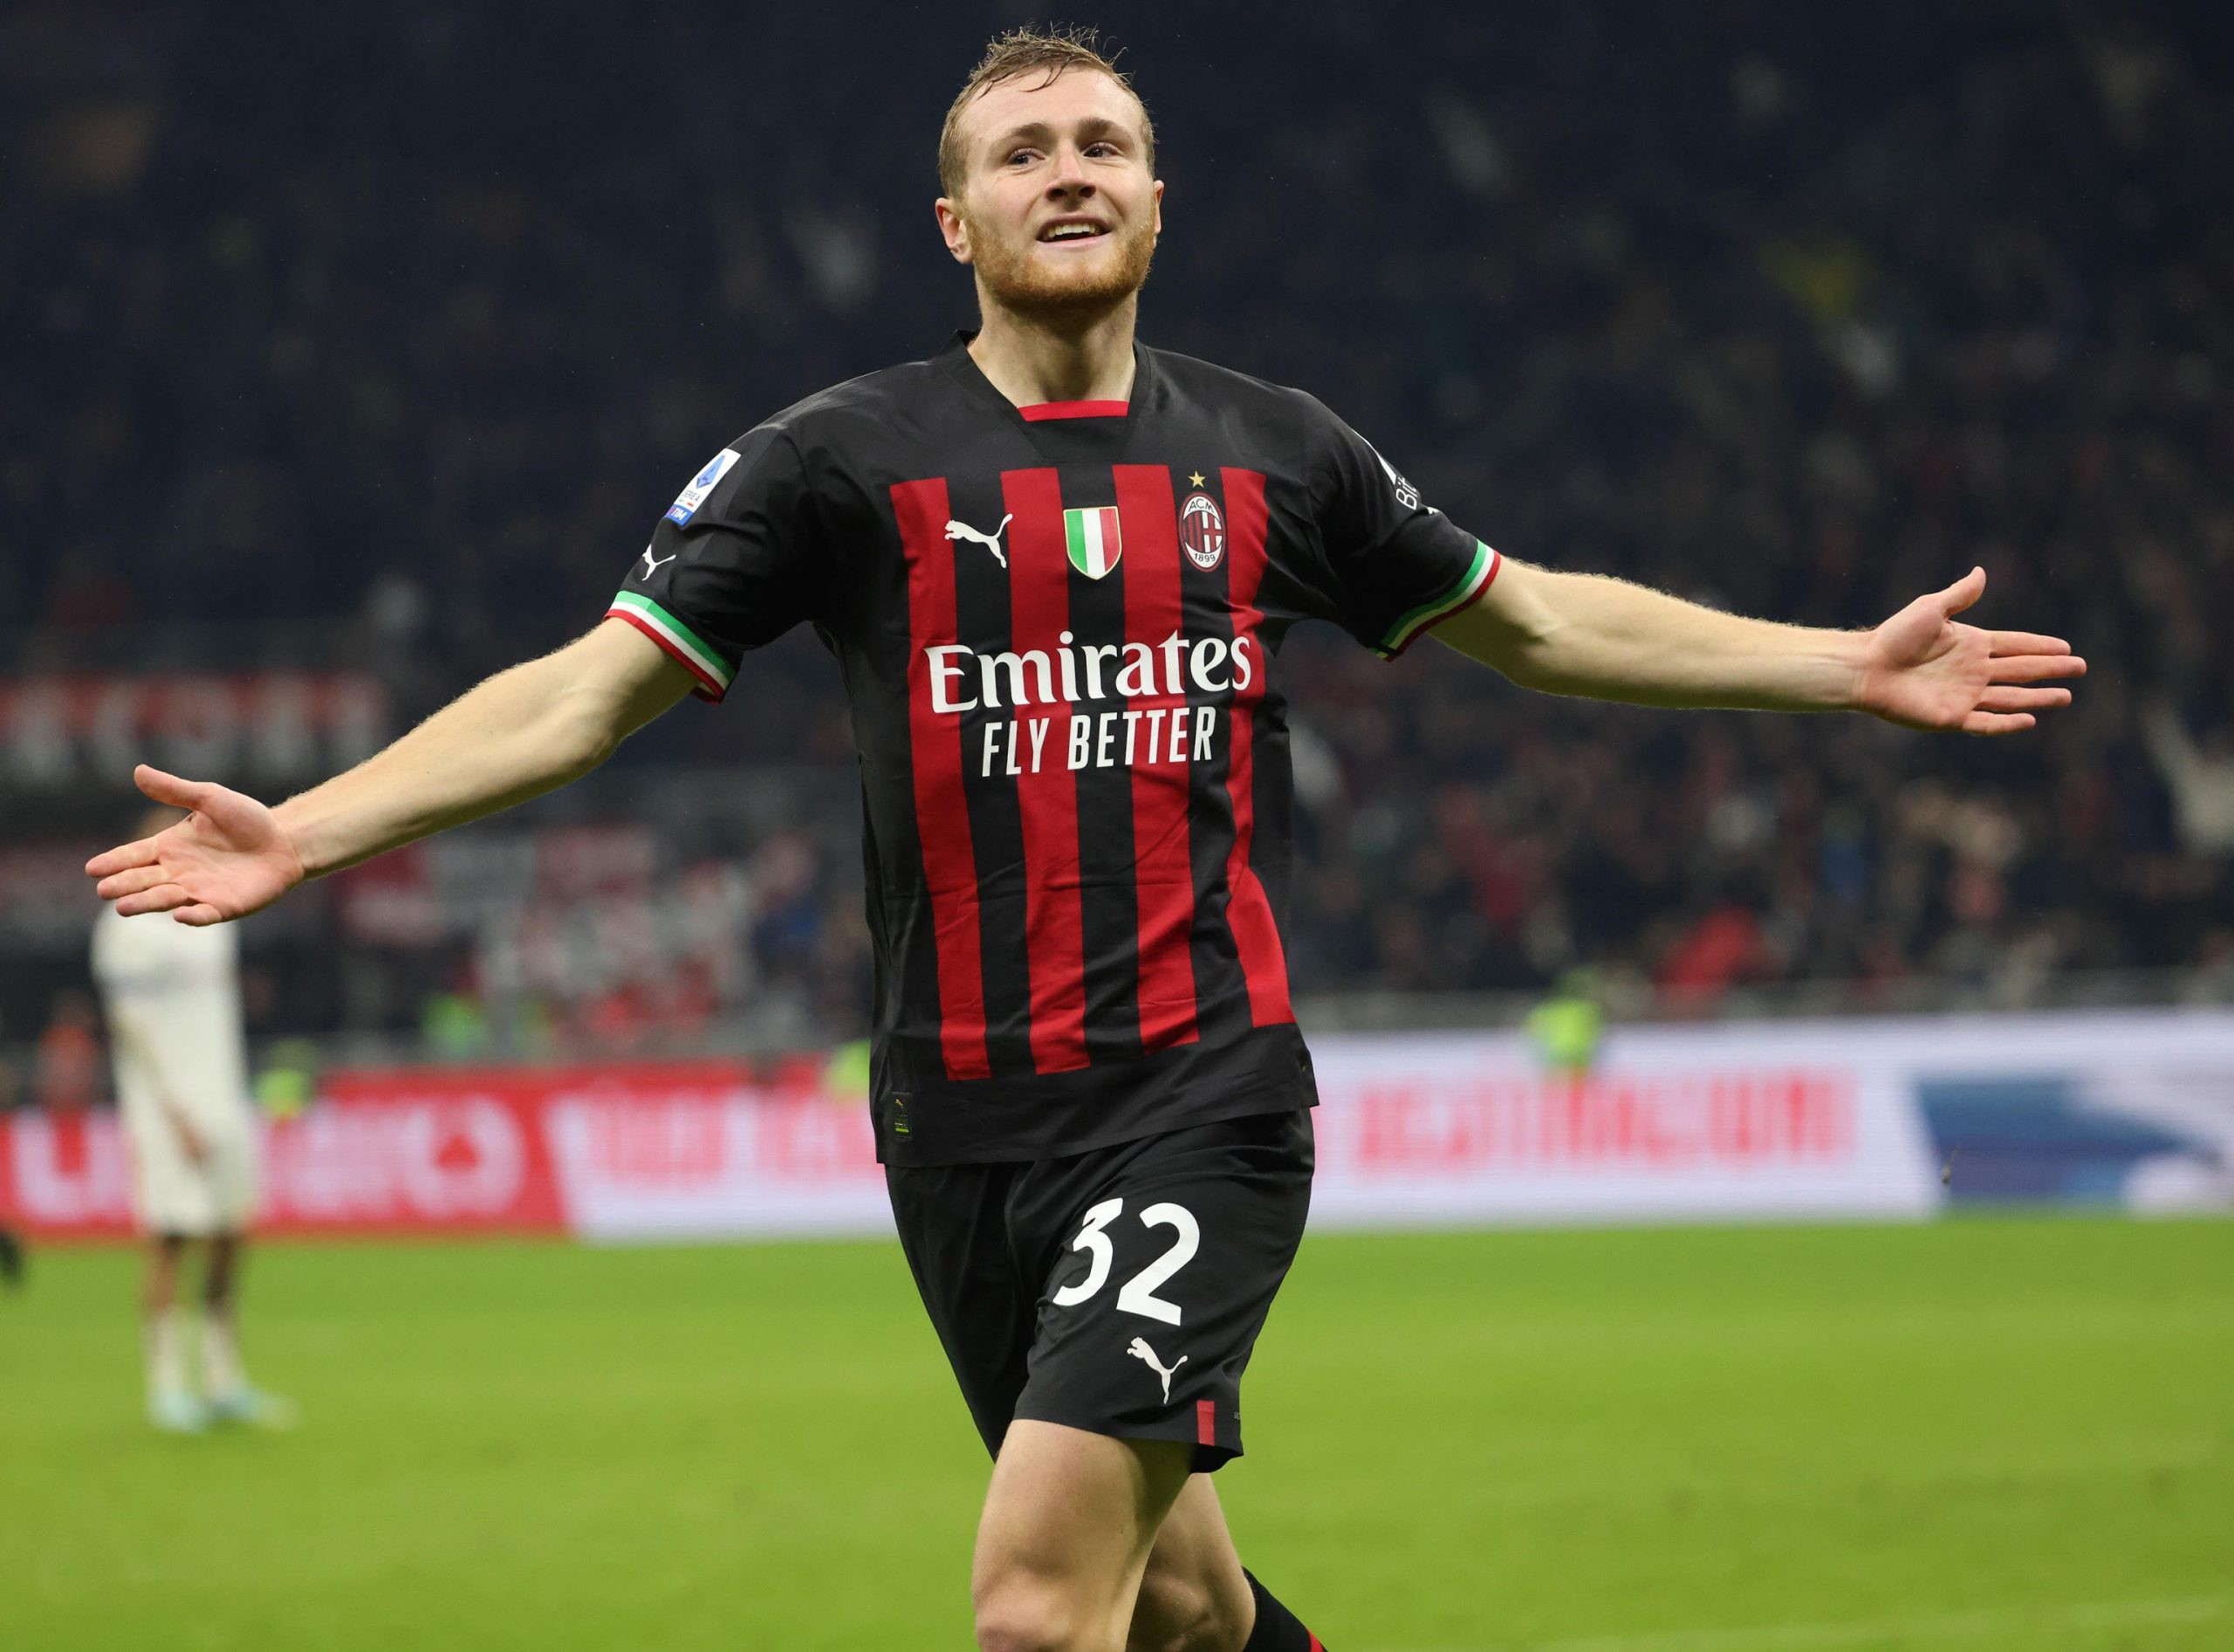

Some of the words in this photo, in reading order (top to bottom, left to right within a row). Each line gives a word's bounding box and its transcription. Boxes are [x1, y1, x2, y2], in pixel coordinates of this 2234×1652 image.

[670, 507, 688, 521] TIM
[1188, 498, 1215, 513] ACM
[1194, 552, 1216, 563] 1899
[923, 629, 1251, 713] Emirates
[982, 717, 1050, 778] FLY
[1067, 706, 1216, 770] BETTER
[1052, 1197, 1201, 1326] 32
